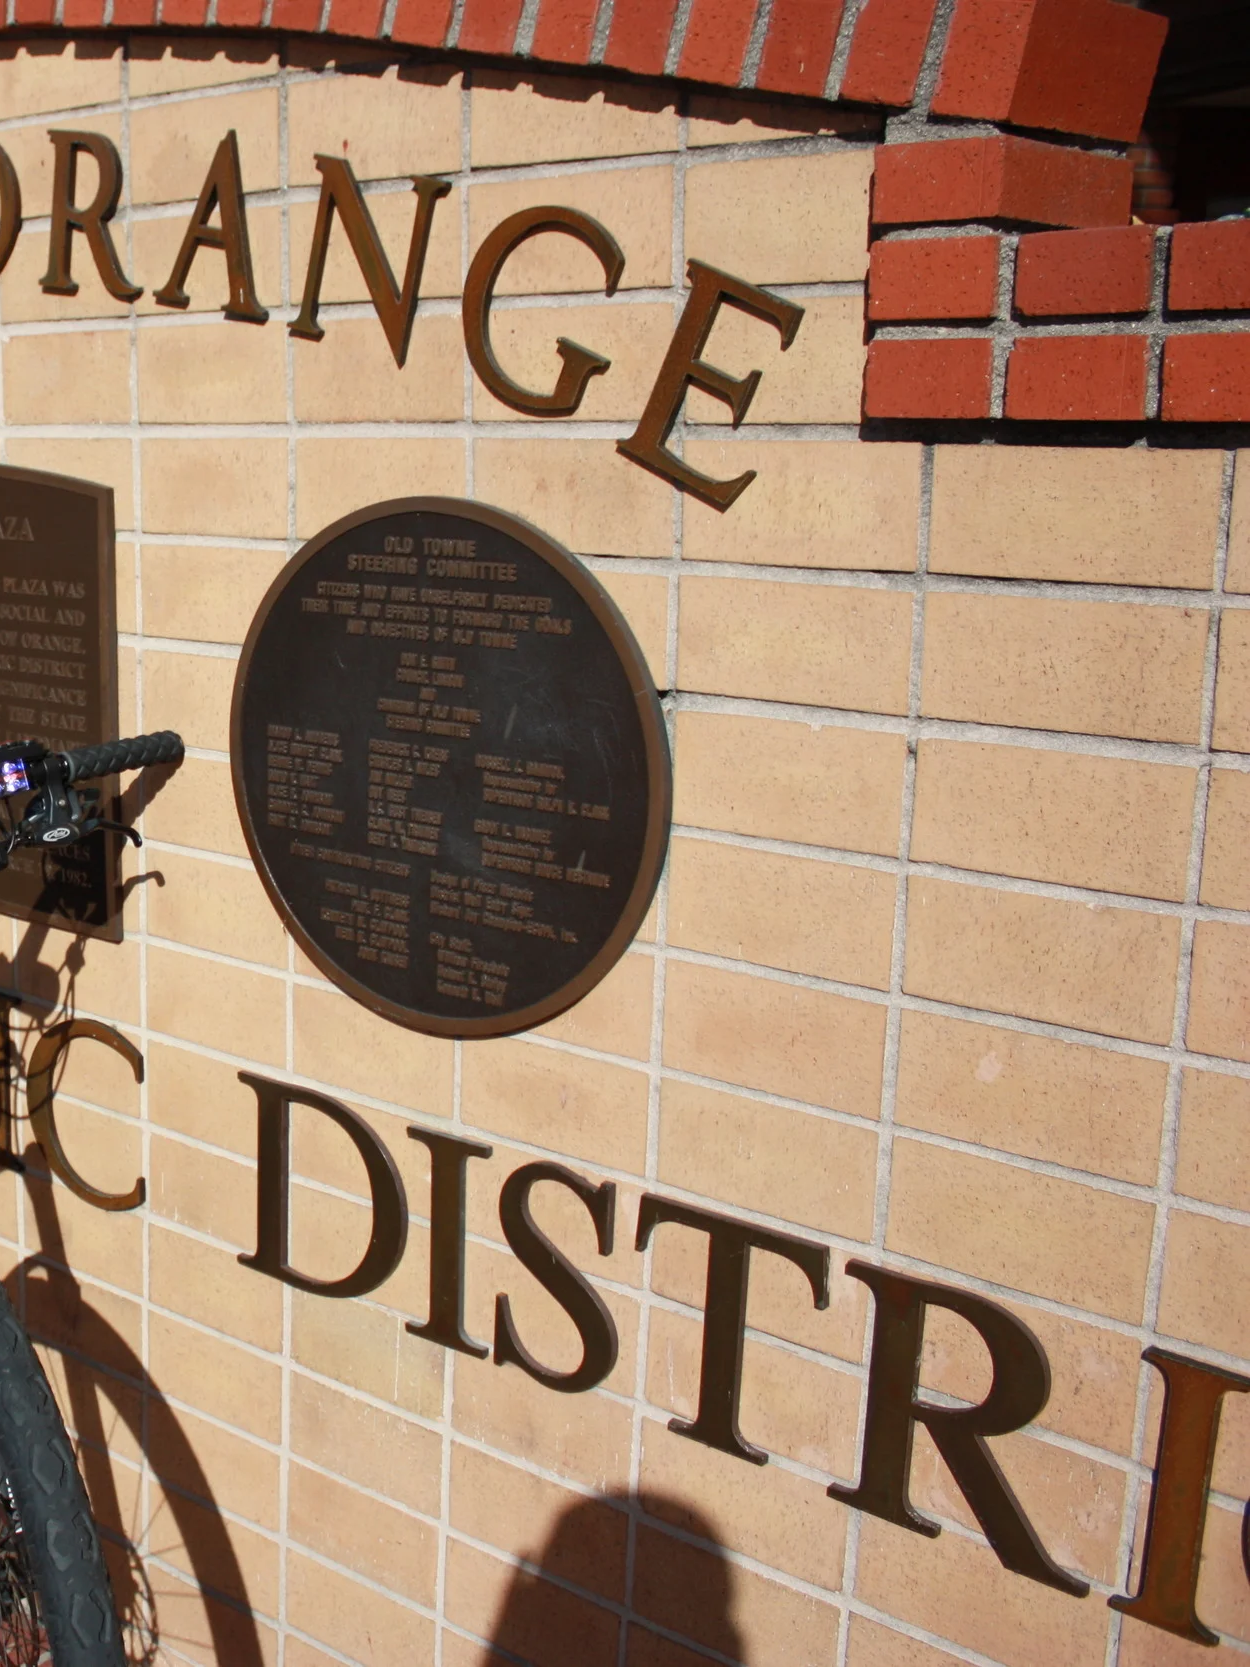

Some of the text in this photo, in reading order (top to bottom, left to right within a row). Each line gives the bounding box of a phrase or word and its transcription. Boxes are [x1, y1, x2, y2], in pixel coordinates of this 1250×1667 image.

[384, 535, 478, 559] OLD TOWNE
[347, 554, 518, 583] STEERING COMMITTEE
[2, 576, 49, 596] PLAZA
[52, 580, 86, 600] WAS
[391, 585, 417, 603] HAVE
[493, 593, 554, 614] DEDICATED
[53, 608, 87, 627] AND
[333, 599, 358, 616] TIME
[385, 604, 430, 623] EFFORTS
[508, 614, 530, 632] THE
[535, 616, 573, 636] GOALS
[20, 631, 87, 655] ORANGE.
[370, 621, 430, 642] OBJECTIVES
[434, 626, 448, 643] OF
[452, 628, 474, 646] OLD
[478, 631, 519, 650] TOWNE
[19, 655, 87, 680] DISTRICT
[6, 705, 36, 725] THE
[39, 710, 87, 732] STATE
[236, 1069, 1250, 1648] DISTRI
